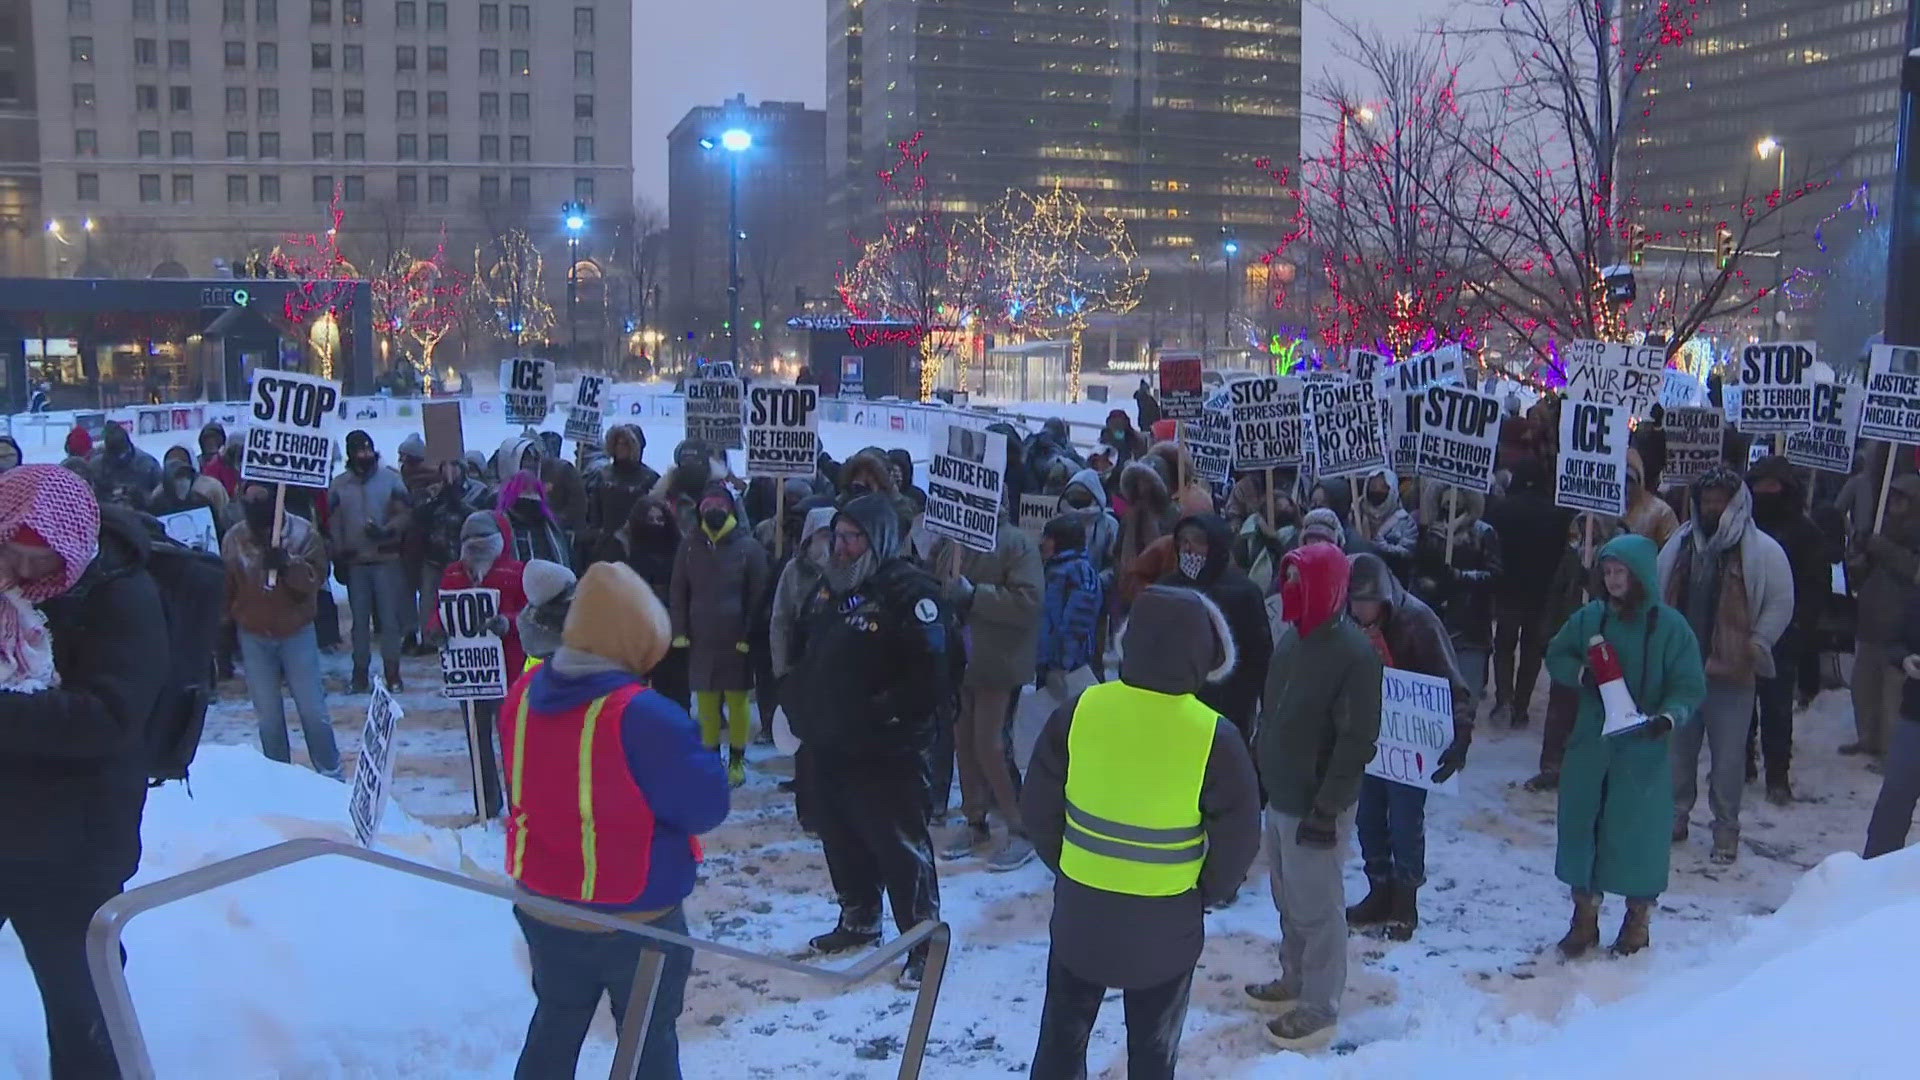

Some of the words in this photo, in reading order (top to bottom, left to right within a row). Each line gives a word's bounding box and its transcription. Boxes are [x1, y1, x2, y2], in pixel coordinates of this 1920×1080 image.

[1572, 353, 1601, 366] WILL
[1619, 345, 1664, 371] ICE
[1574, 341, 1606, 354] WHO
[511, 359, 545, 391] ICE
[1742, 345, 1813, 385] STOP
[577, 375, 604, 408] ICE
[688, 382, 739, 399] CLEVELAND
[1231, 379, 1278, 405] STOP
[1570, 364, 1661, 397] MURDER
[1870, 372, 1919, 396] JUSTICE
[253, 376, 337, 429] STOP
[750, 387, 817, 428] STOP
[1313, 381, 1374, 412] POWER
[1741, 389, 1760, 407] ICE
[1764, 389, 1810, 407] TERROR
[1812, 383, 1847, 425] CE
[688, 416, 741, 426] STOP
[1233, 401, 1301, 422] REPRESSION
[1315, 402, 1378, 434] PEOPLE
[1425, 386, 1499, 438] STOP
[1666, 411, 1720, 429] CLEVELAND
[1741, 407, 1810, 420] NOW!
[1864, 407, 1905, 427] NICOLE
[749, 430, 768, 448] ICE
[770, 431, 815, 450] TERROR
[1235, 419, 1302, 443] ABOLISH
[1318, 431, 1341, 452] NO
[1346, 423, 1380, 447] ONE
[1400, 435, 1418, 450] OUT
[1572, 404, 1613, 455] ICE
[1826, 428, 1847, 445] OUR
[248, 428, 271, 452] ICE
[274, 430, 330, 458] TERROR
[749, 449, 814, 463] NOW!
[1236, 442, 1259, 460] ICE
[1264, 439, 1302, 459] NOW!
[1420, 433, 1440, 454] ICE
[1444, 439, 1492, 465] TERROR
[1668, 449, 1719, 460] STOP
[1788, 436, 1850, 461] COMMUNITIES
[246, 450, 326, 474] NOW!
[930, 454, 976, 486] JUSTICE
[976, 467, 1000, 493] FOR
[1420, 453, 1489, 479] NOW!
[1565, 458, 1583, 477] OUT
[1583, 460, 1596, 479] OF
[1597, 462, 1616, 482] OUR
[929, 481, 998, 514] RENEE
[1560, 475, 1621, 501] COMMUNITIES
[926, 497, 963, 527] NICOLE
[964, 509, 996, 538] GOOD
[440, 592, 494, 638] TOP
[449, 647, 500, 669] TERROR
